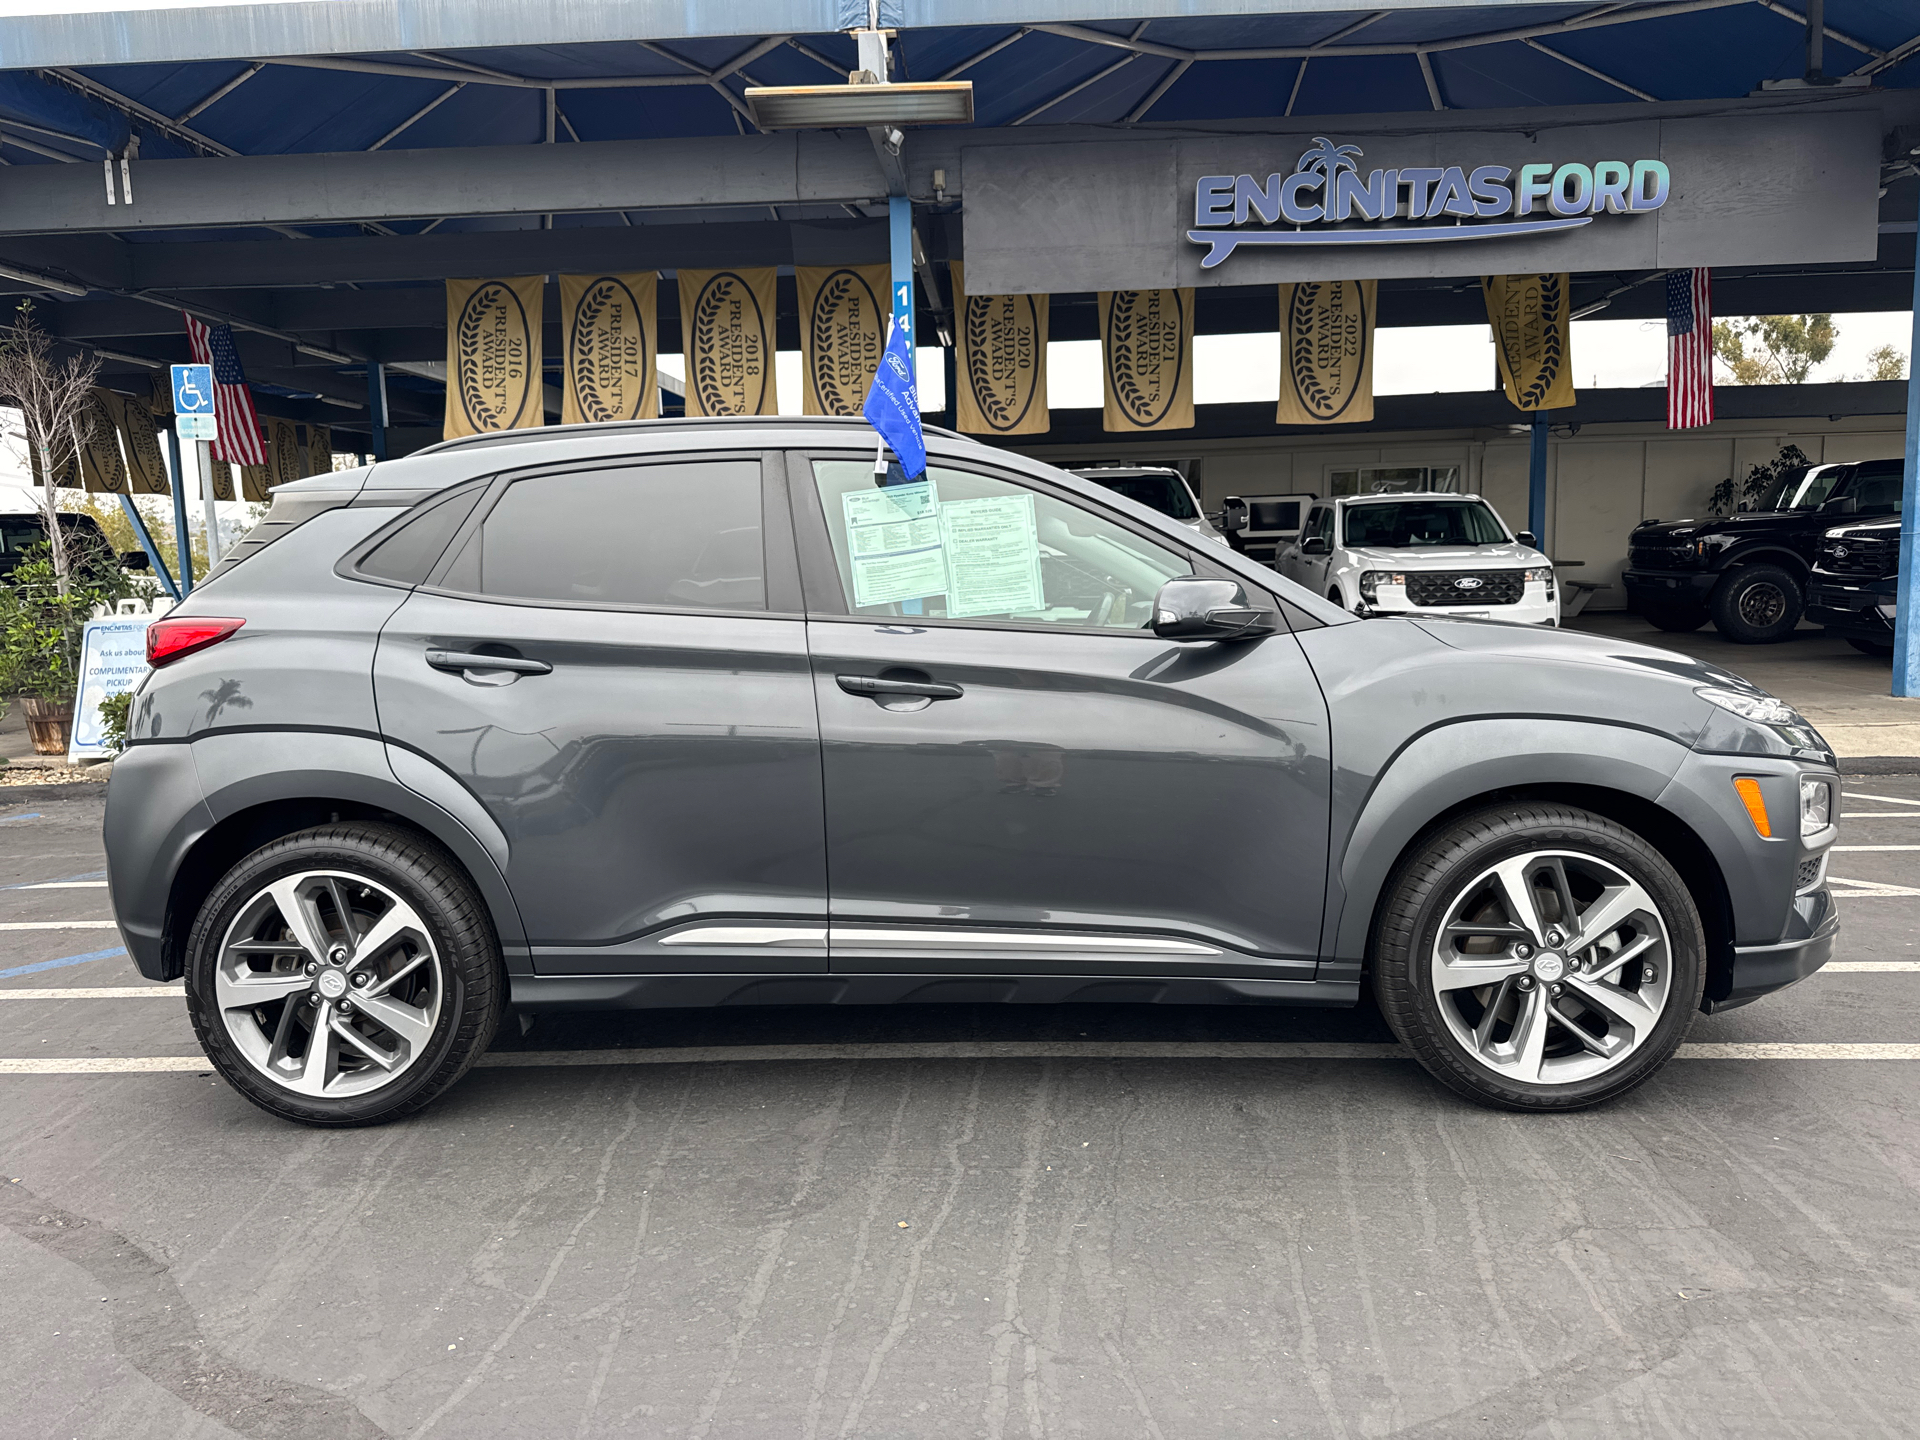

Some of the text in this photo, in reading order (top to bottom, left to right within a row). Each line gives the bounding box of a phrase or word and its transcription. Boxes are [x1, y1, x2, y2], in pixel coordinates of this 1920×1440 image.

[1195, 159, 1671, 226] ENCINITAS FORD
[718, 324, 732, 388] AWARD
[745, 334, 759, 376] 2018
[836, 322, 851, 387] AWARD
[848, 296, 864, 412] PRESIDENT'S
[863, 332, 878, 374] 2019
[991, 317, 1004, 381] AWARD
[1017, 326, 1031, 369] 2020
[1135, 312, 1148, 377] AWARD
[1162, 321, 1176, 362] 2021
[1317, 304, 1329, 370] AWARD
[1343, 314, 1358, 357] 2022
[1504, 275, 1522, 392] RESIDENT
[1523, 286, 1541, 364] AWARD
[482, 329, 494, 390] AWARD
[494, 305, 507, 415] PRESIDENT'S
[508, 338, 523, 379] 2016
[598, 327, 611, 389] AWARD
[610, 303, 623, 415] PRESIDENT'S
[624, 336, 638, 378] 2017
[730, 299, 746, 414] PRESIDENT'S
[887, 356, 907, 378] Ford
[898, 404, 911, 425] Used
[909, 423, 923, 451] Vehicle
[1457, 578, 1480, 588] Ford
[100, 649, 113, 657] Ask
[106, 678, 133, 687] PICKUP
[312, 851, 460, 969] EAGLE TOURING
